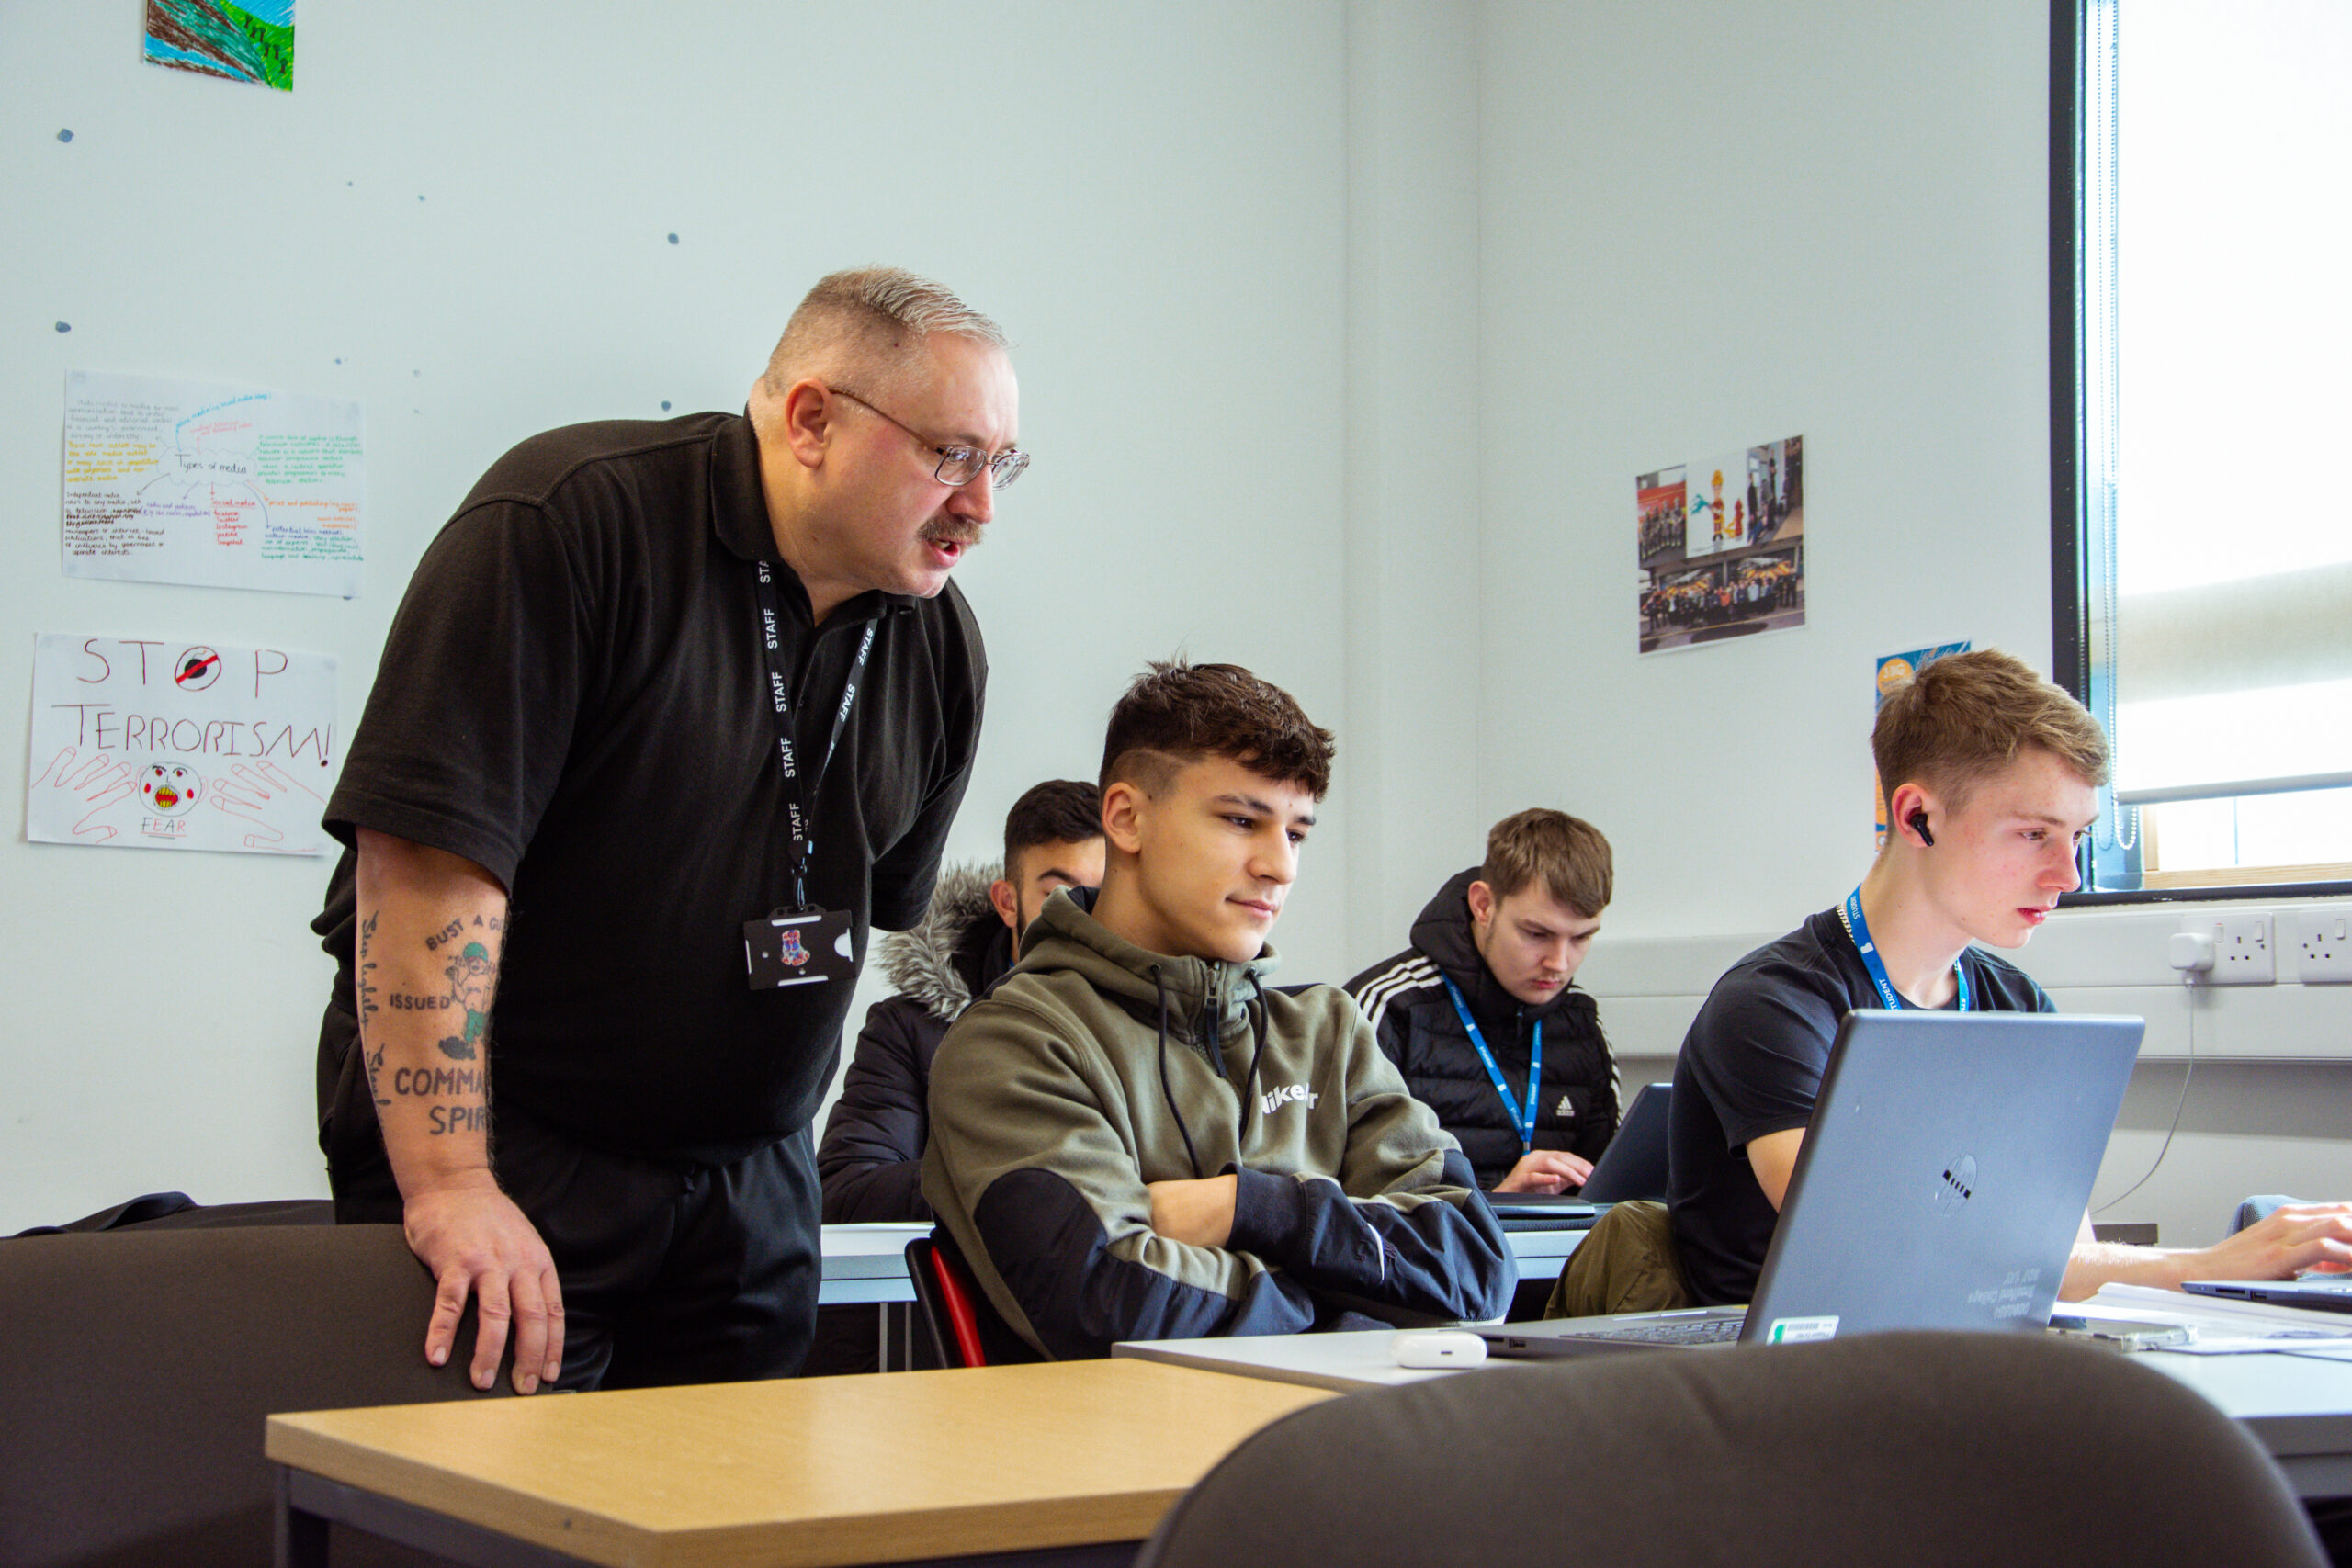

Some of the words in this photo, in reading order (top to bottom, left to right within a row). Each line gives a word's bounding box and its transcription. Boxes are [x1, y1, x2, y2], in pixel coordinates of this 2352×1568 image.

[174, 454, 203, 474] Types
[208, 461, 217, 469] of
[220, 463, 247, 474] media
[235, 498, 256, 506] media
[763, 607, 778, 650] STAFF
[859, 627, 874, 667] STAFF
[771, 671, 787, 713] STAFF
[840, 683, 855, 723] STAFF
[51, 703, 331, 768] TERRORISM!
[780, 737, 797, 779] STAFF
[141, 816, 187, 833] FEAR
[789, 803, 804, 842] STAFF
[425, 917, 464, 952] BUST
[473, 914, 483, 928] A
[390, 994, 451, 1010] ISSUED
